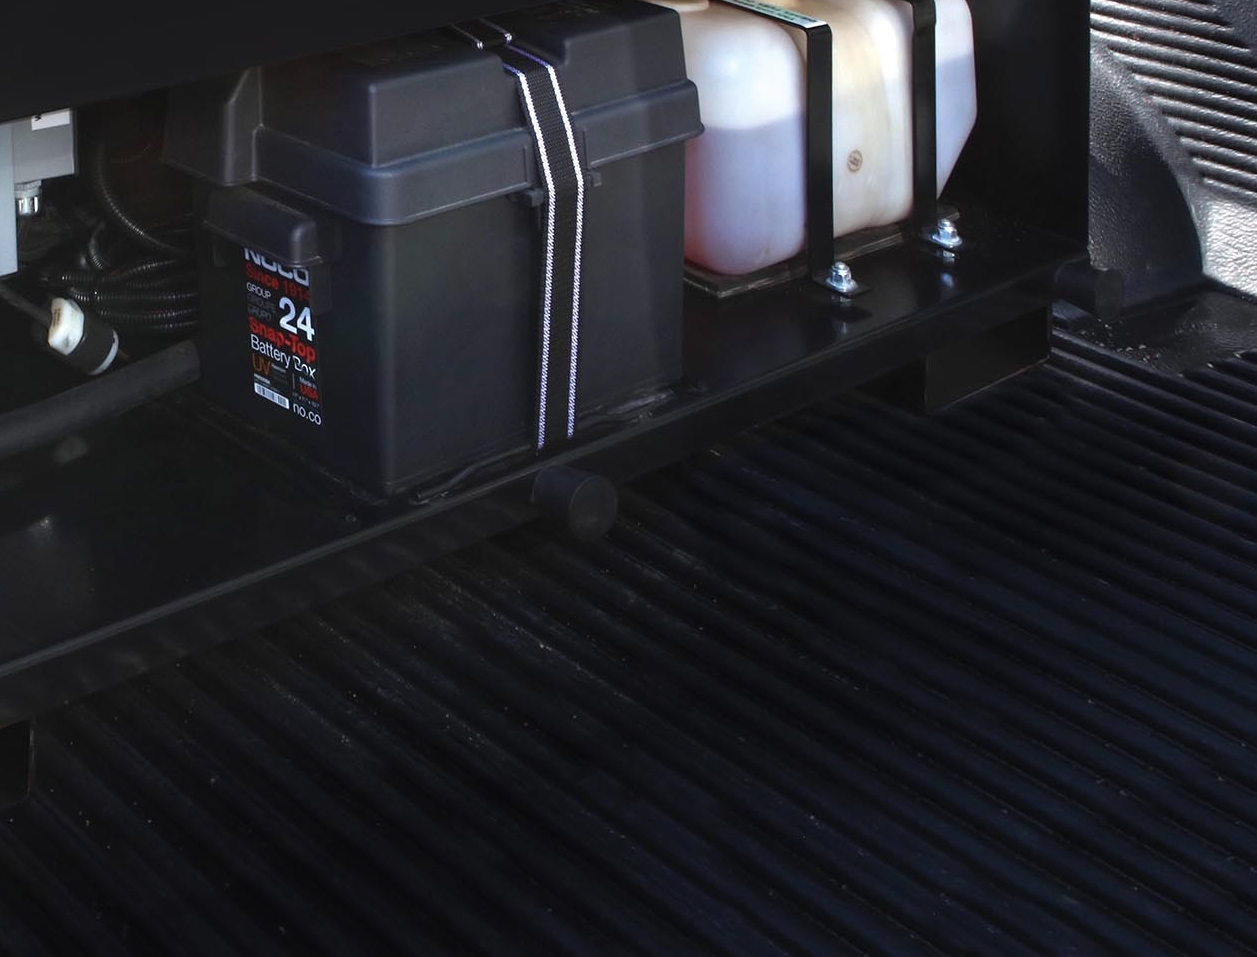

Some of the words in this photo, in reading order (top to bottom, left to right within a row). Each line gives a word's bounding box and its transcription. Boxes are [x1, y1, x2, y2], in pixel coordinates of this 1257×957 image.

[246, 282, 272, 300] GROUP
[279, 296, 316, 342] 24
[248, 315, 317, 364] Snap-Top
[250, 333, 291, 369] Battery
[292, 355, 317, 380] Box
[252, 353, 272, 376] UV
[293, 403, 322, 426] no.co
